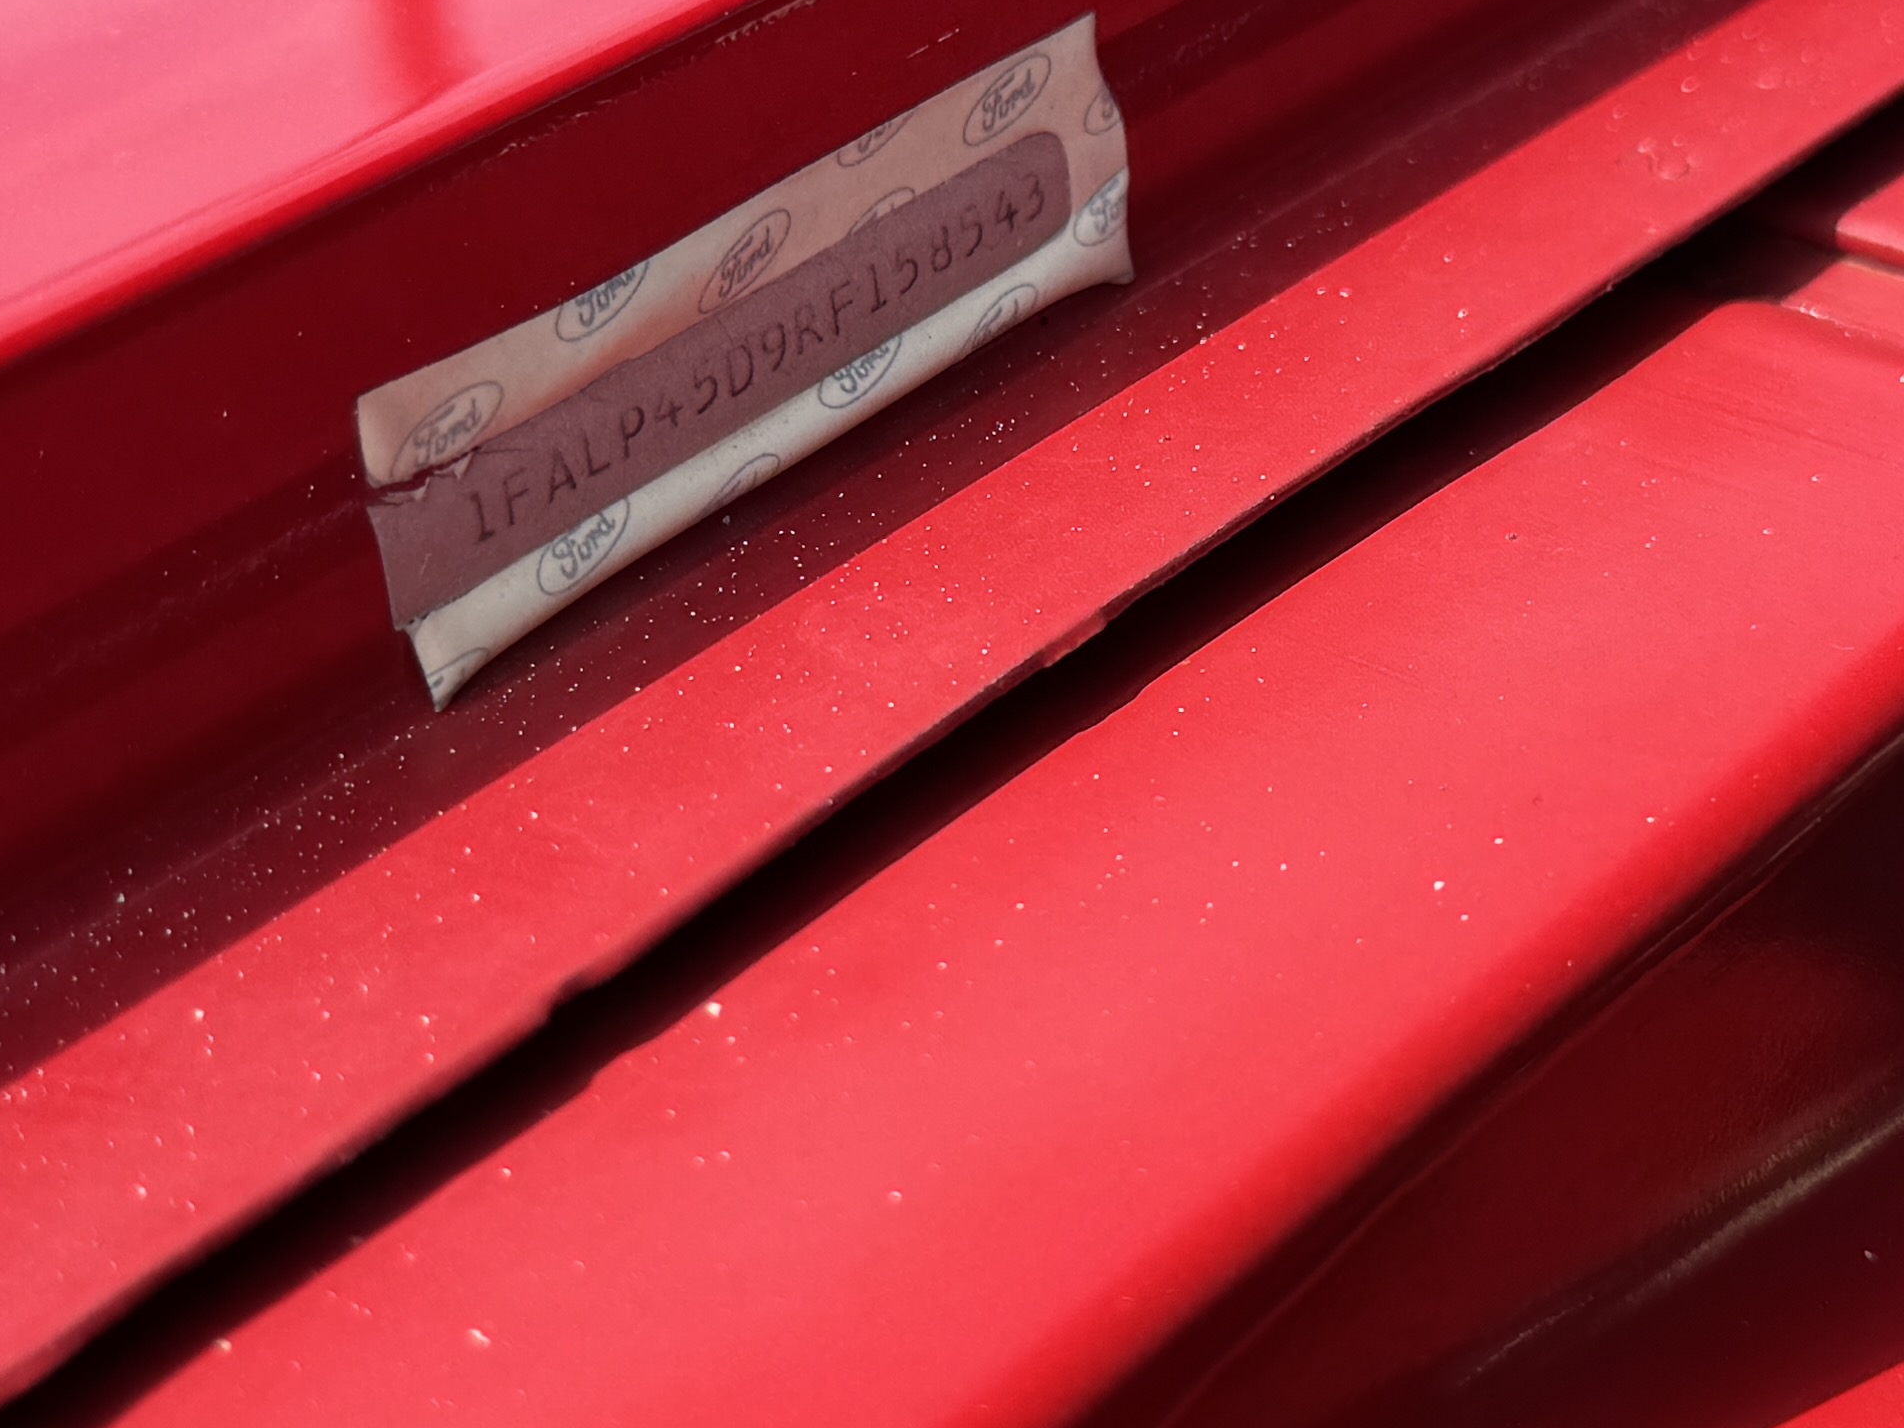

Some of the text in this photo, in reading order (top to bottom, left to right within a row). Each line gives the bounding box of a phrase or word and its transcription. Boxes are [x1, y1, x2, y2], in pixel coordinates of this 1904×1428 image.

[982, 68, 1035, 132] Ford
[719, 225, 773, 298] Ford
[469, 172, 1046, 543] 1FALP45D9RF158543
[414, 397, 482, 470] Ford
[552, 511, 616, 579] Ford
